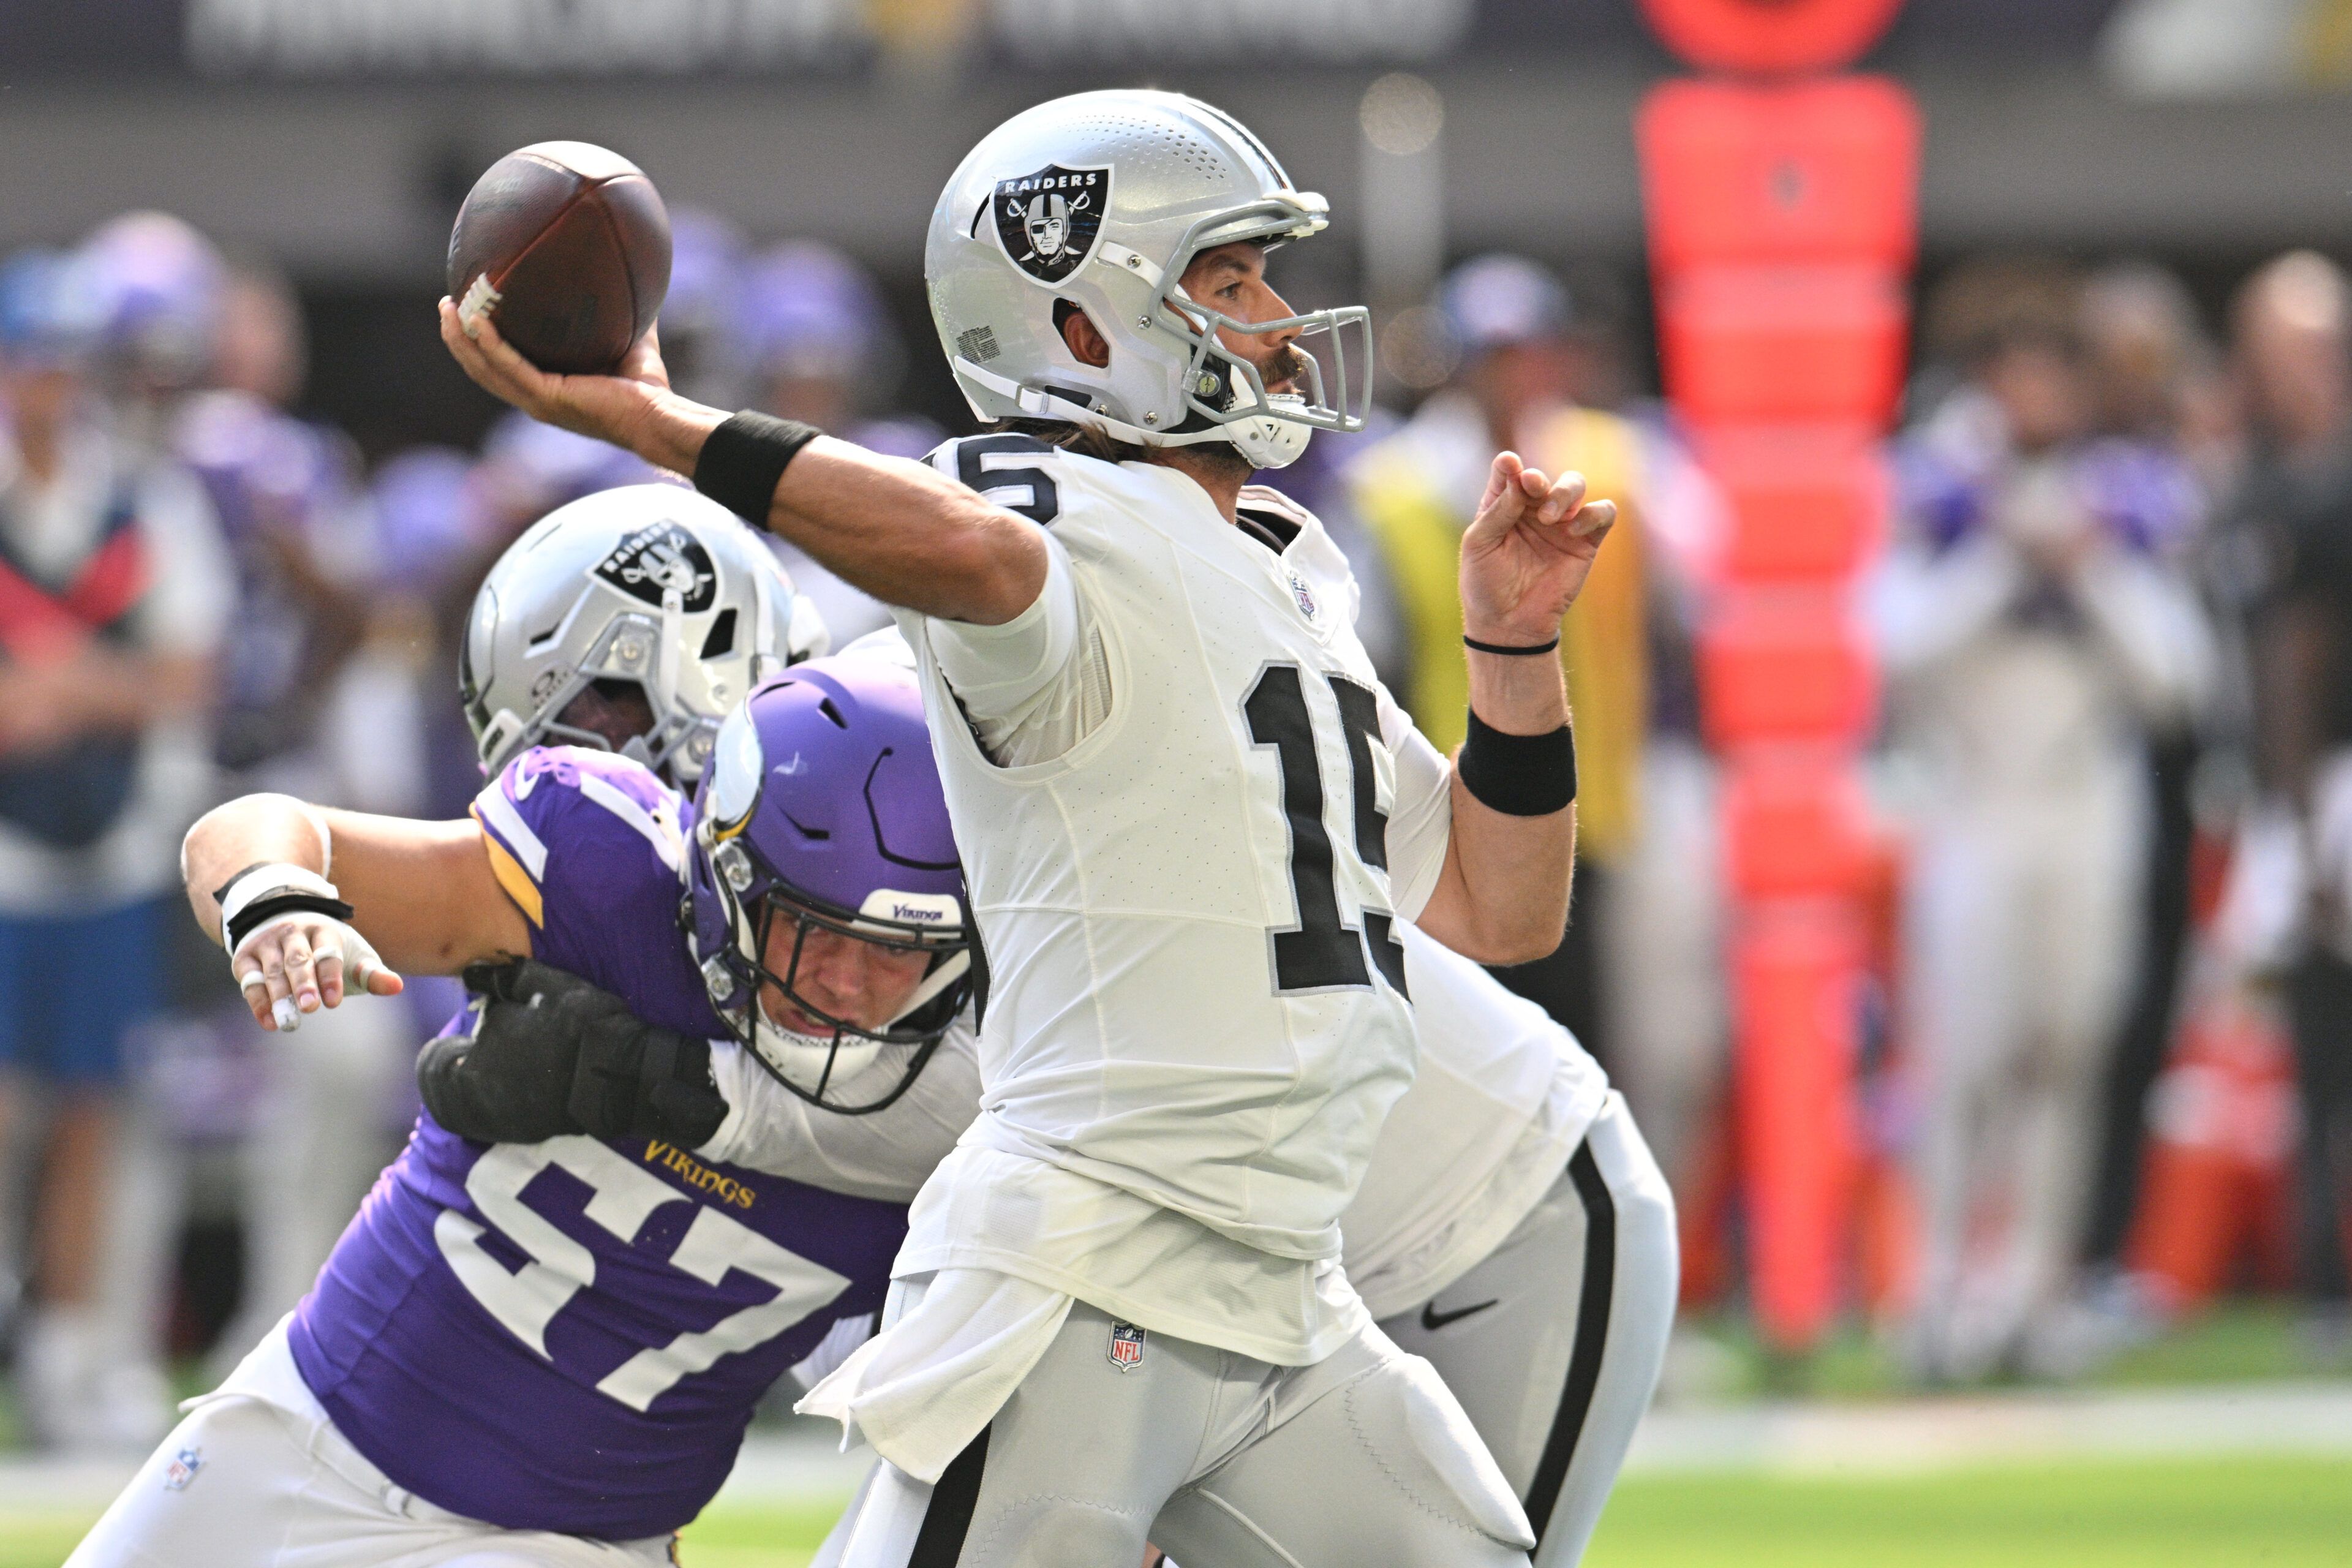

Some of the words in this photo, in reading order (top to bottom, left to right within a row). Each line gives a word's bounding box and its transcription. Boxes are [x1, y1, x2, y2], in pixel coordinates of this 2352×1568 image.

[1005, 173, 1096, 194] RAIDERS
[920, 434, 1060, 526] 5
[1238, 660, 1412, 1006] 15
[644, 1140, 756, 1208] VIKINGS
[434, 1134, 853, 1412] 57
[1114, 1341, 1139, 1362] NFL
